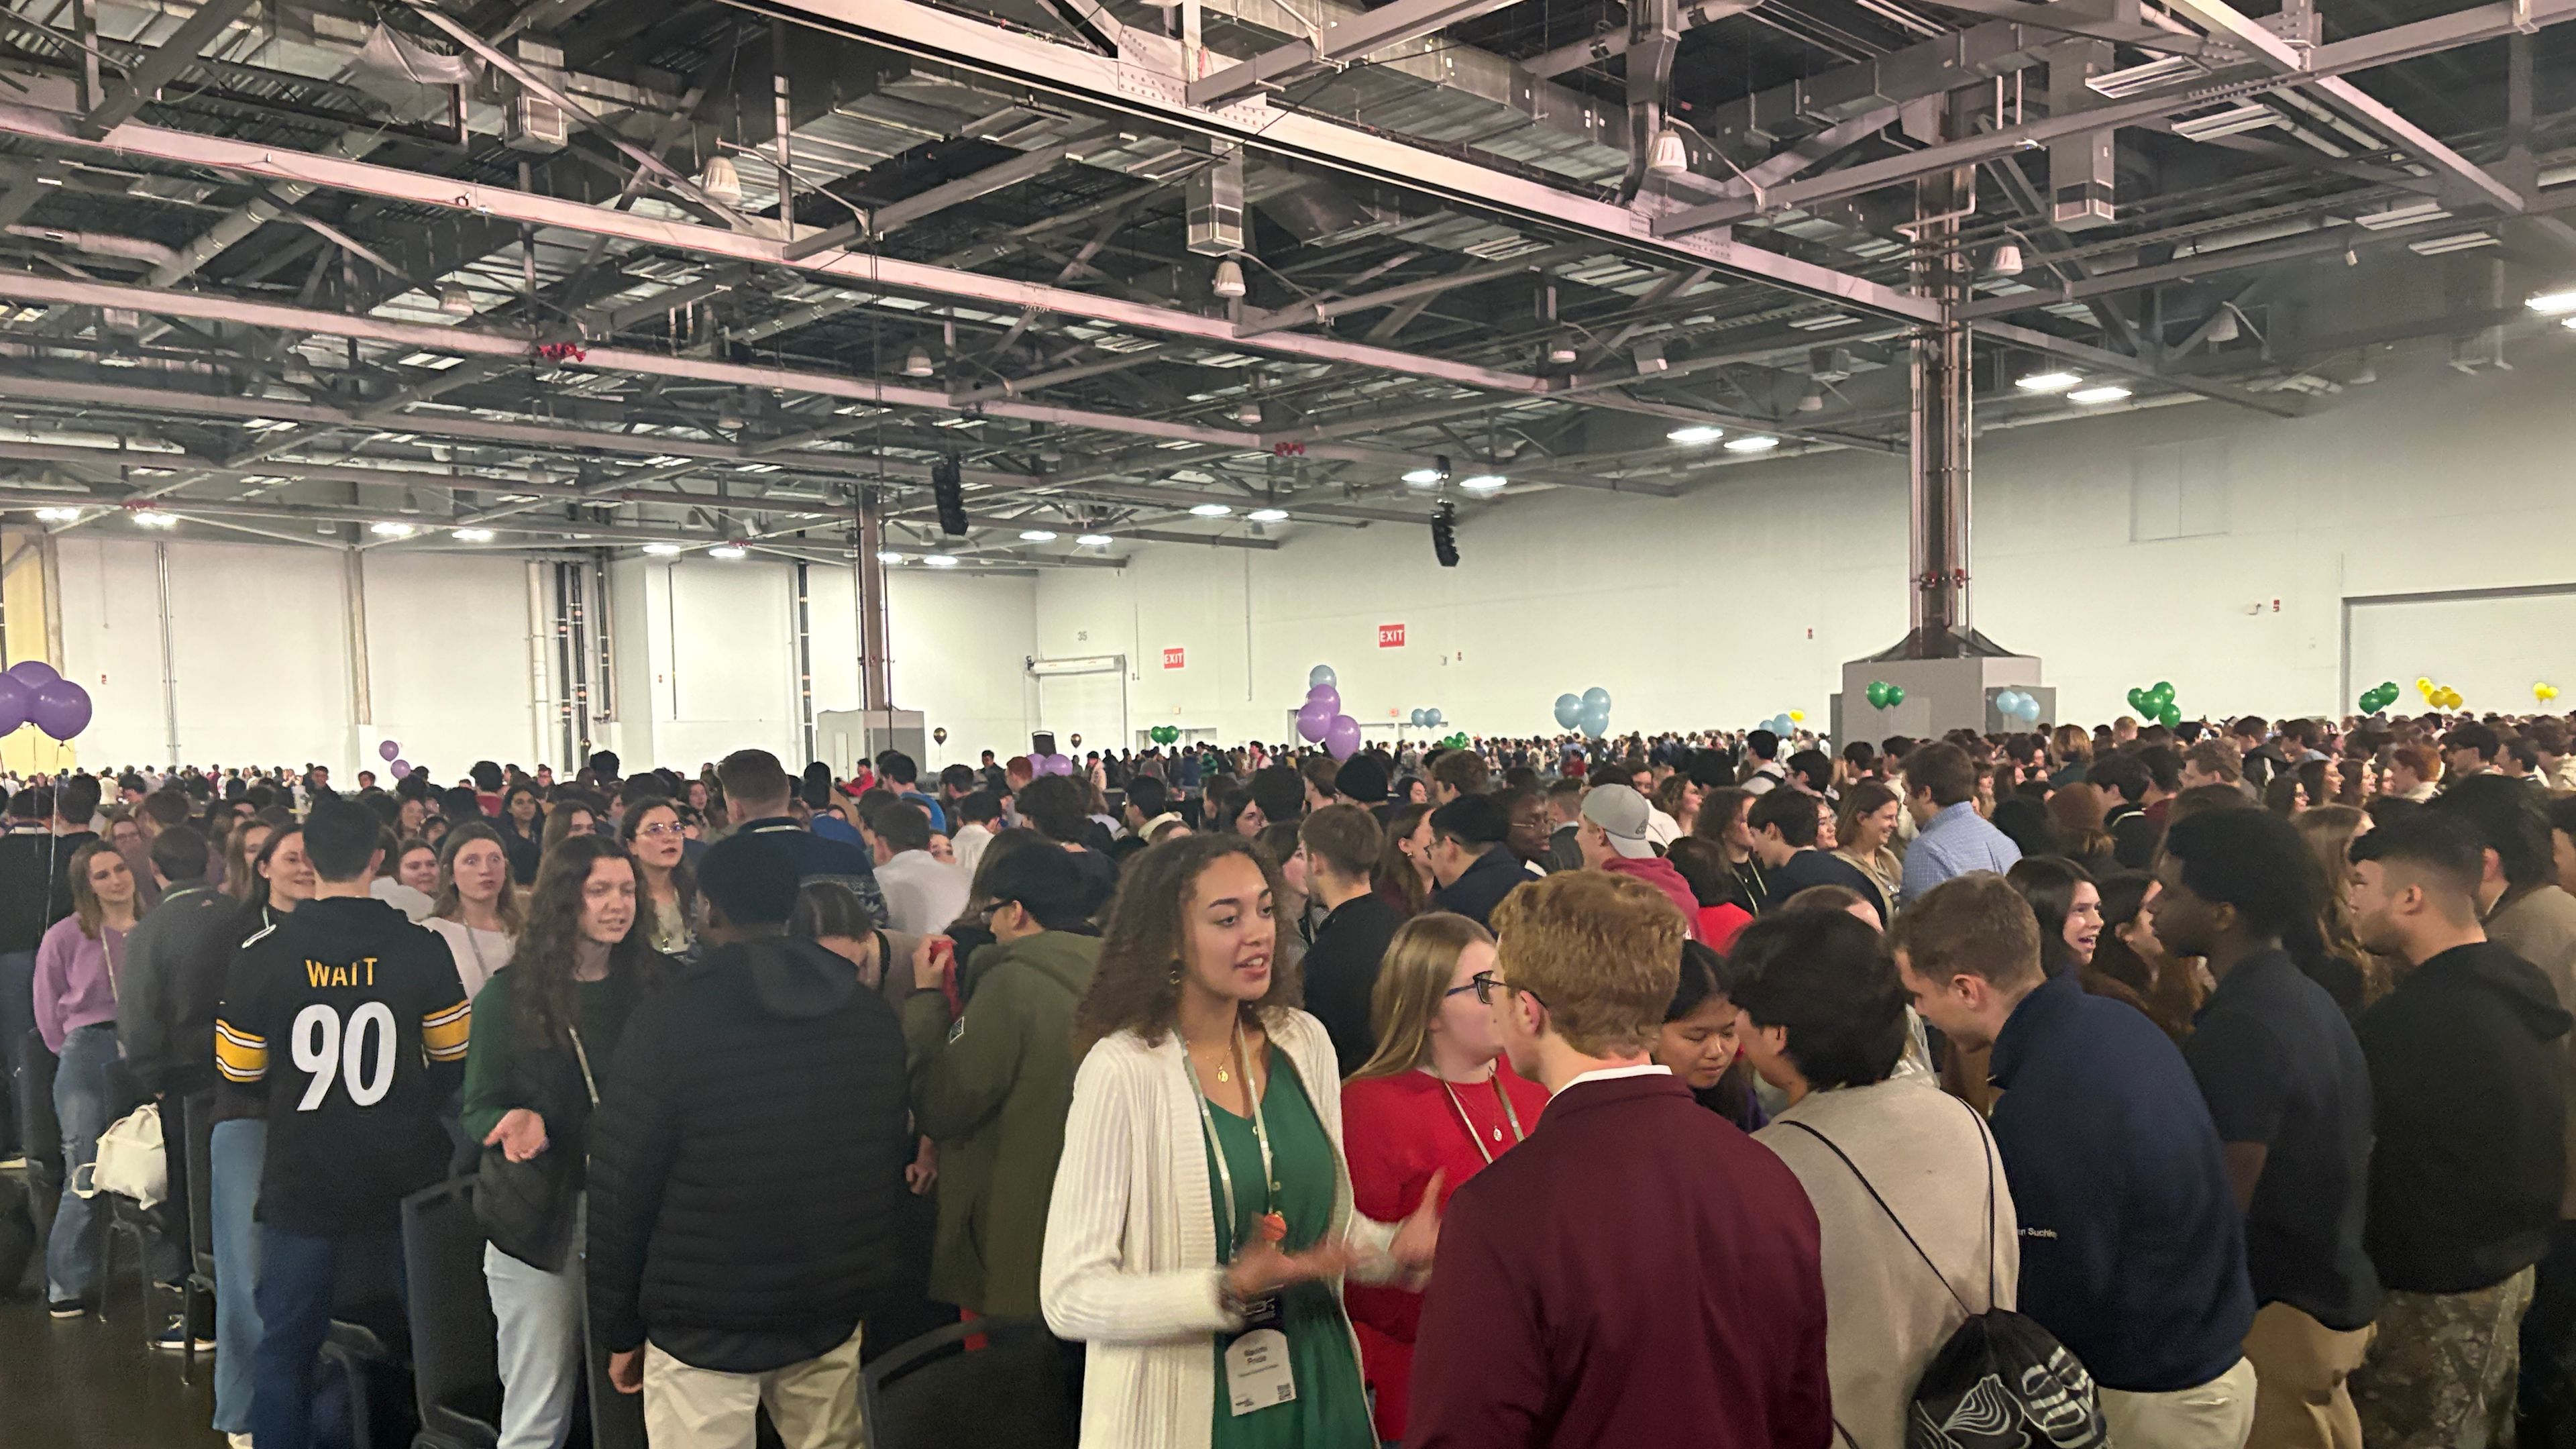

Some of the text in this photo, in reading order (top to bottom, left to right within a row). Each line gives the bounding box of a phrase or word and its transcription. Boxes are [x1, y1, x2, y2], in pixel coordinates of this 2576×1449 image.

[1078, 631, 1087, 641] 35
[1380, 630, 1403, 642] EXIT
[1164, 653, 1183, 664] EXIT
[292, 1002, 397, 1111] 90
